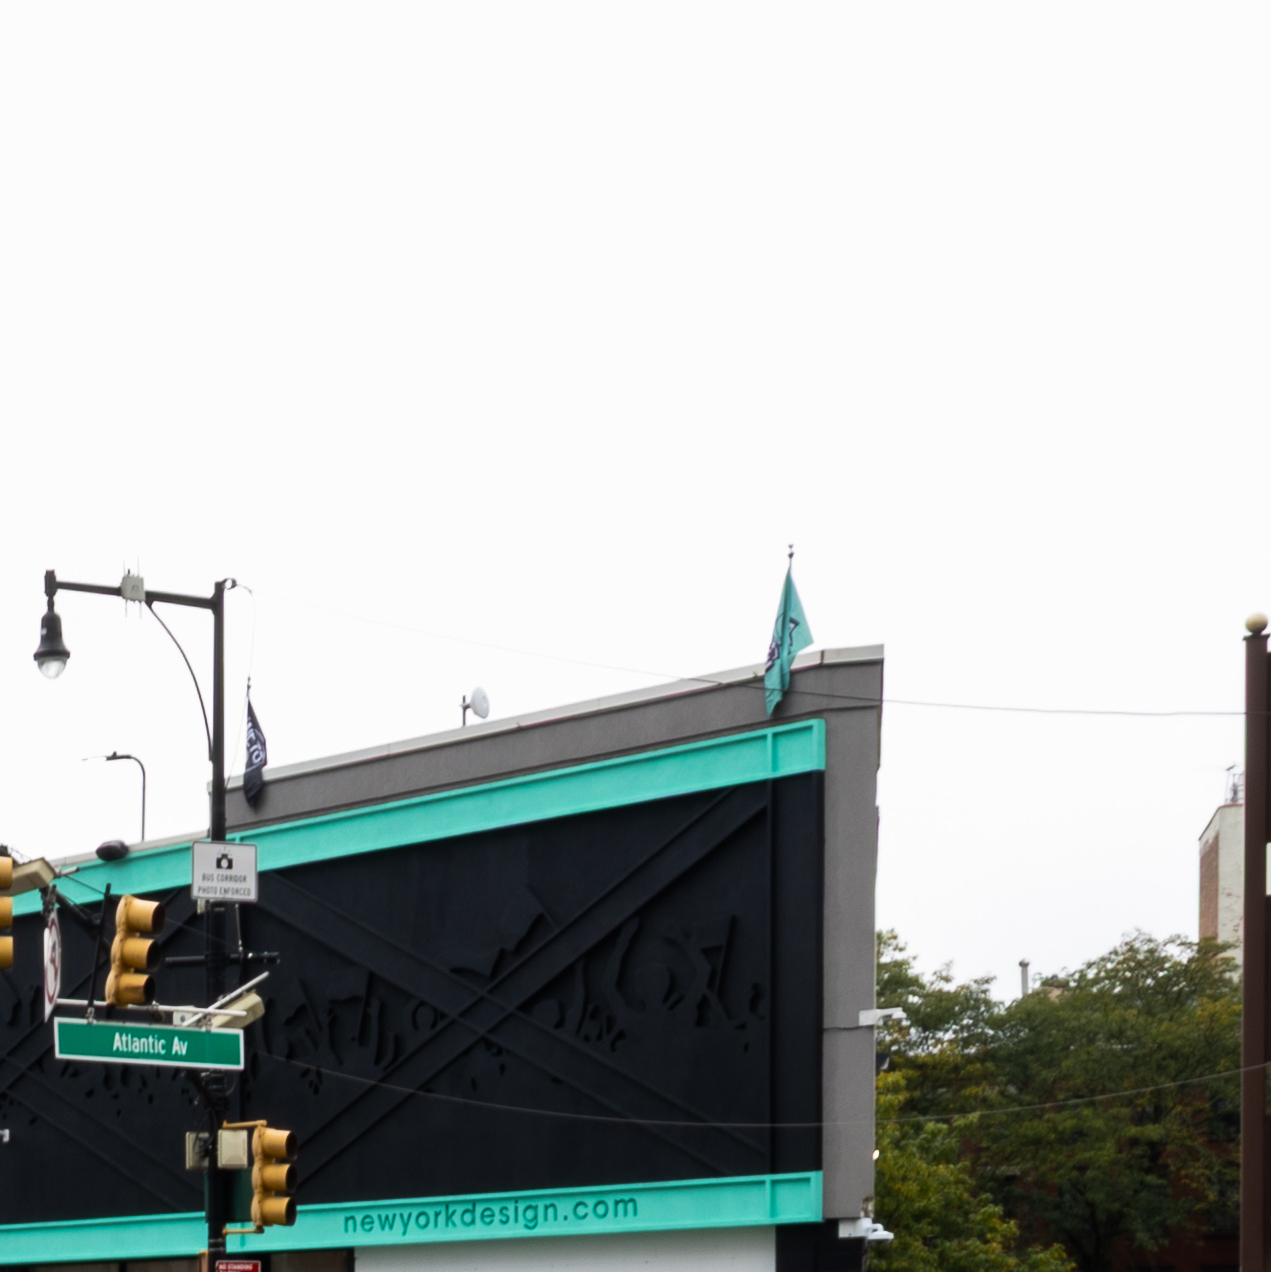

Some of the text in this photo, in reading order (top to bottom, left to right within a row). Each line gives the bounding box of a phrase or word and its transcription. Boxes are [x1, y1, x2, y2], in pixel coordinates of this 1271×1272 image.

[202, 873, 246, 883] BUS CORRIDOR
[198, 885, 251, 897] PHOTO ENFORCED
[112, 1032, 188, 1056] Atlantic Av
[343, 1196, 639, 1236] newyorkdesign.com
